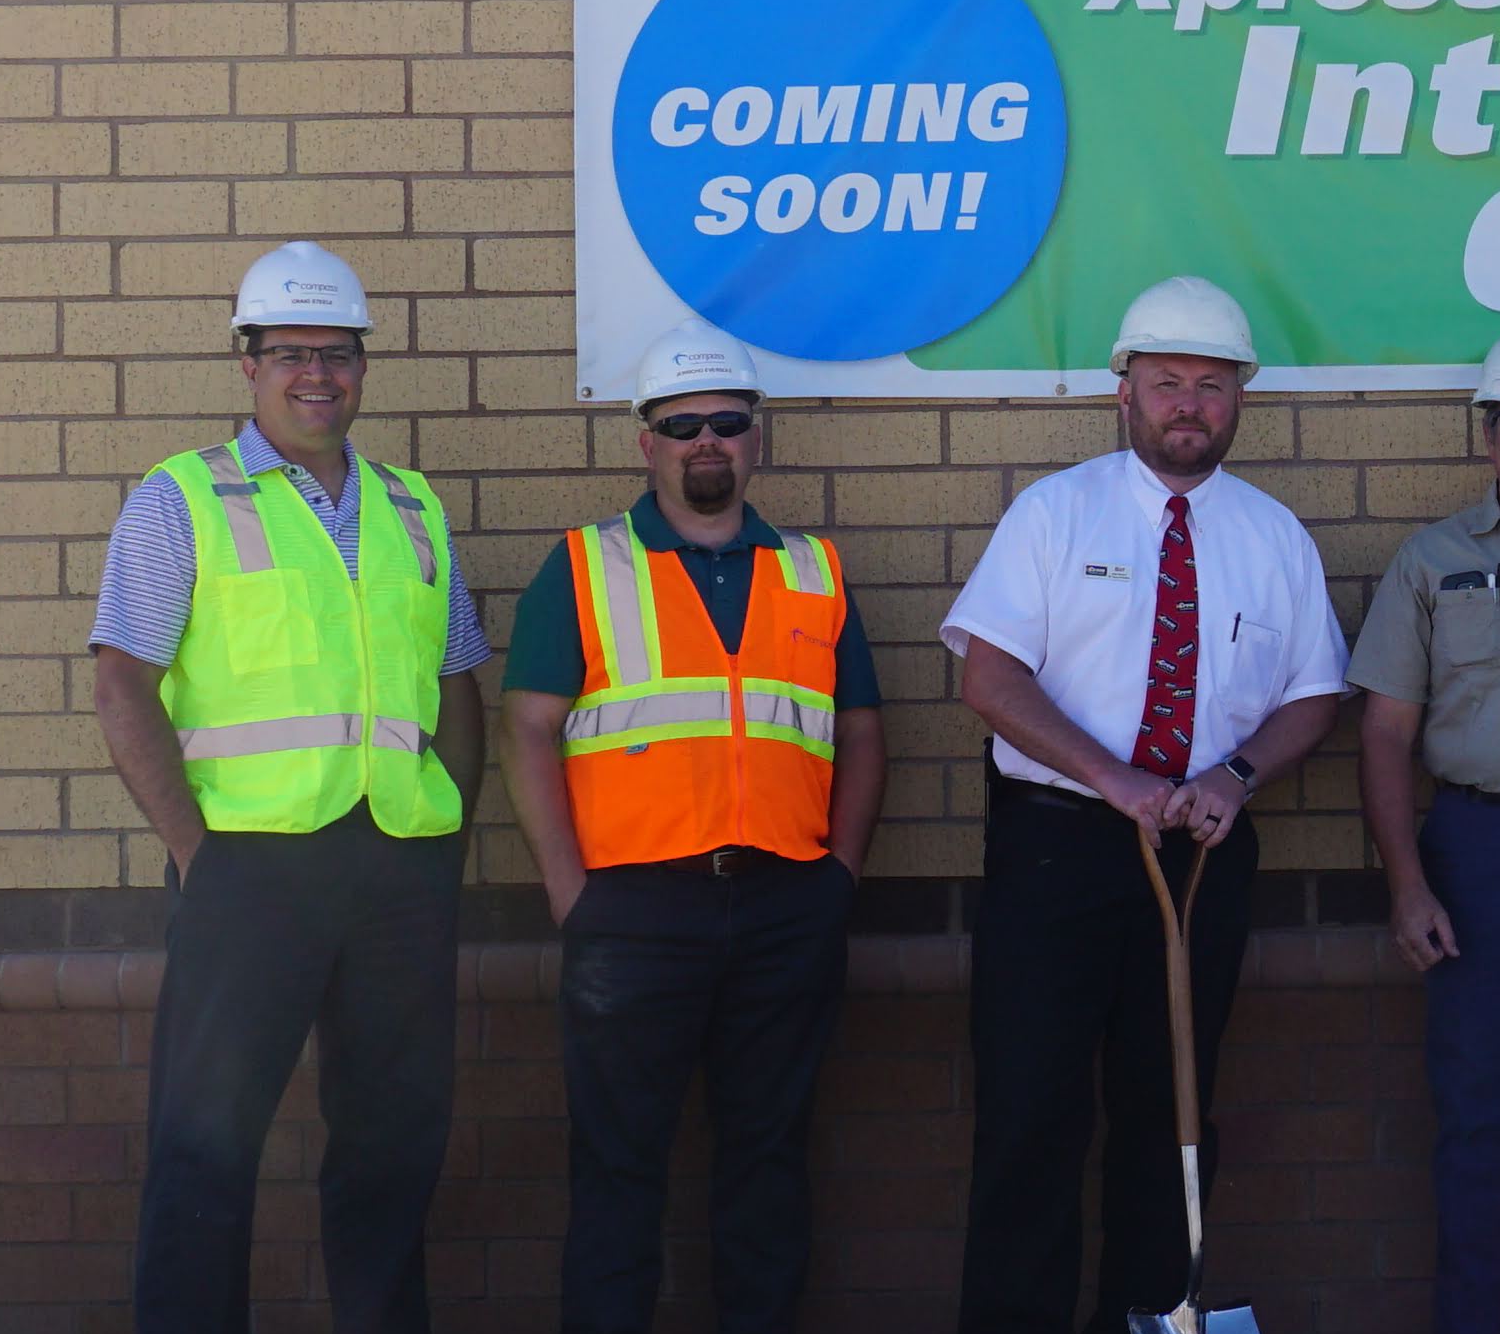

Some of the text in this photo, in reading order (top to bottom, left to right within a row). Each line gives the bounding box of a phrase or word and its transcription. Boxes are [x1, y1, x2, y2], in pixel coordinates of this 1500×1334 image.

[650, 82, 1030, 147] COMING
[694, 172, 988, 235] SOON!
[688, 353, 725, 361] compass
